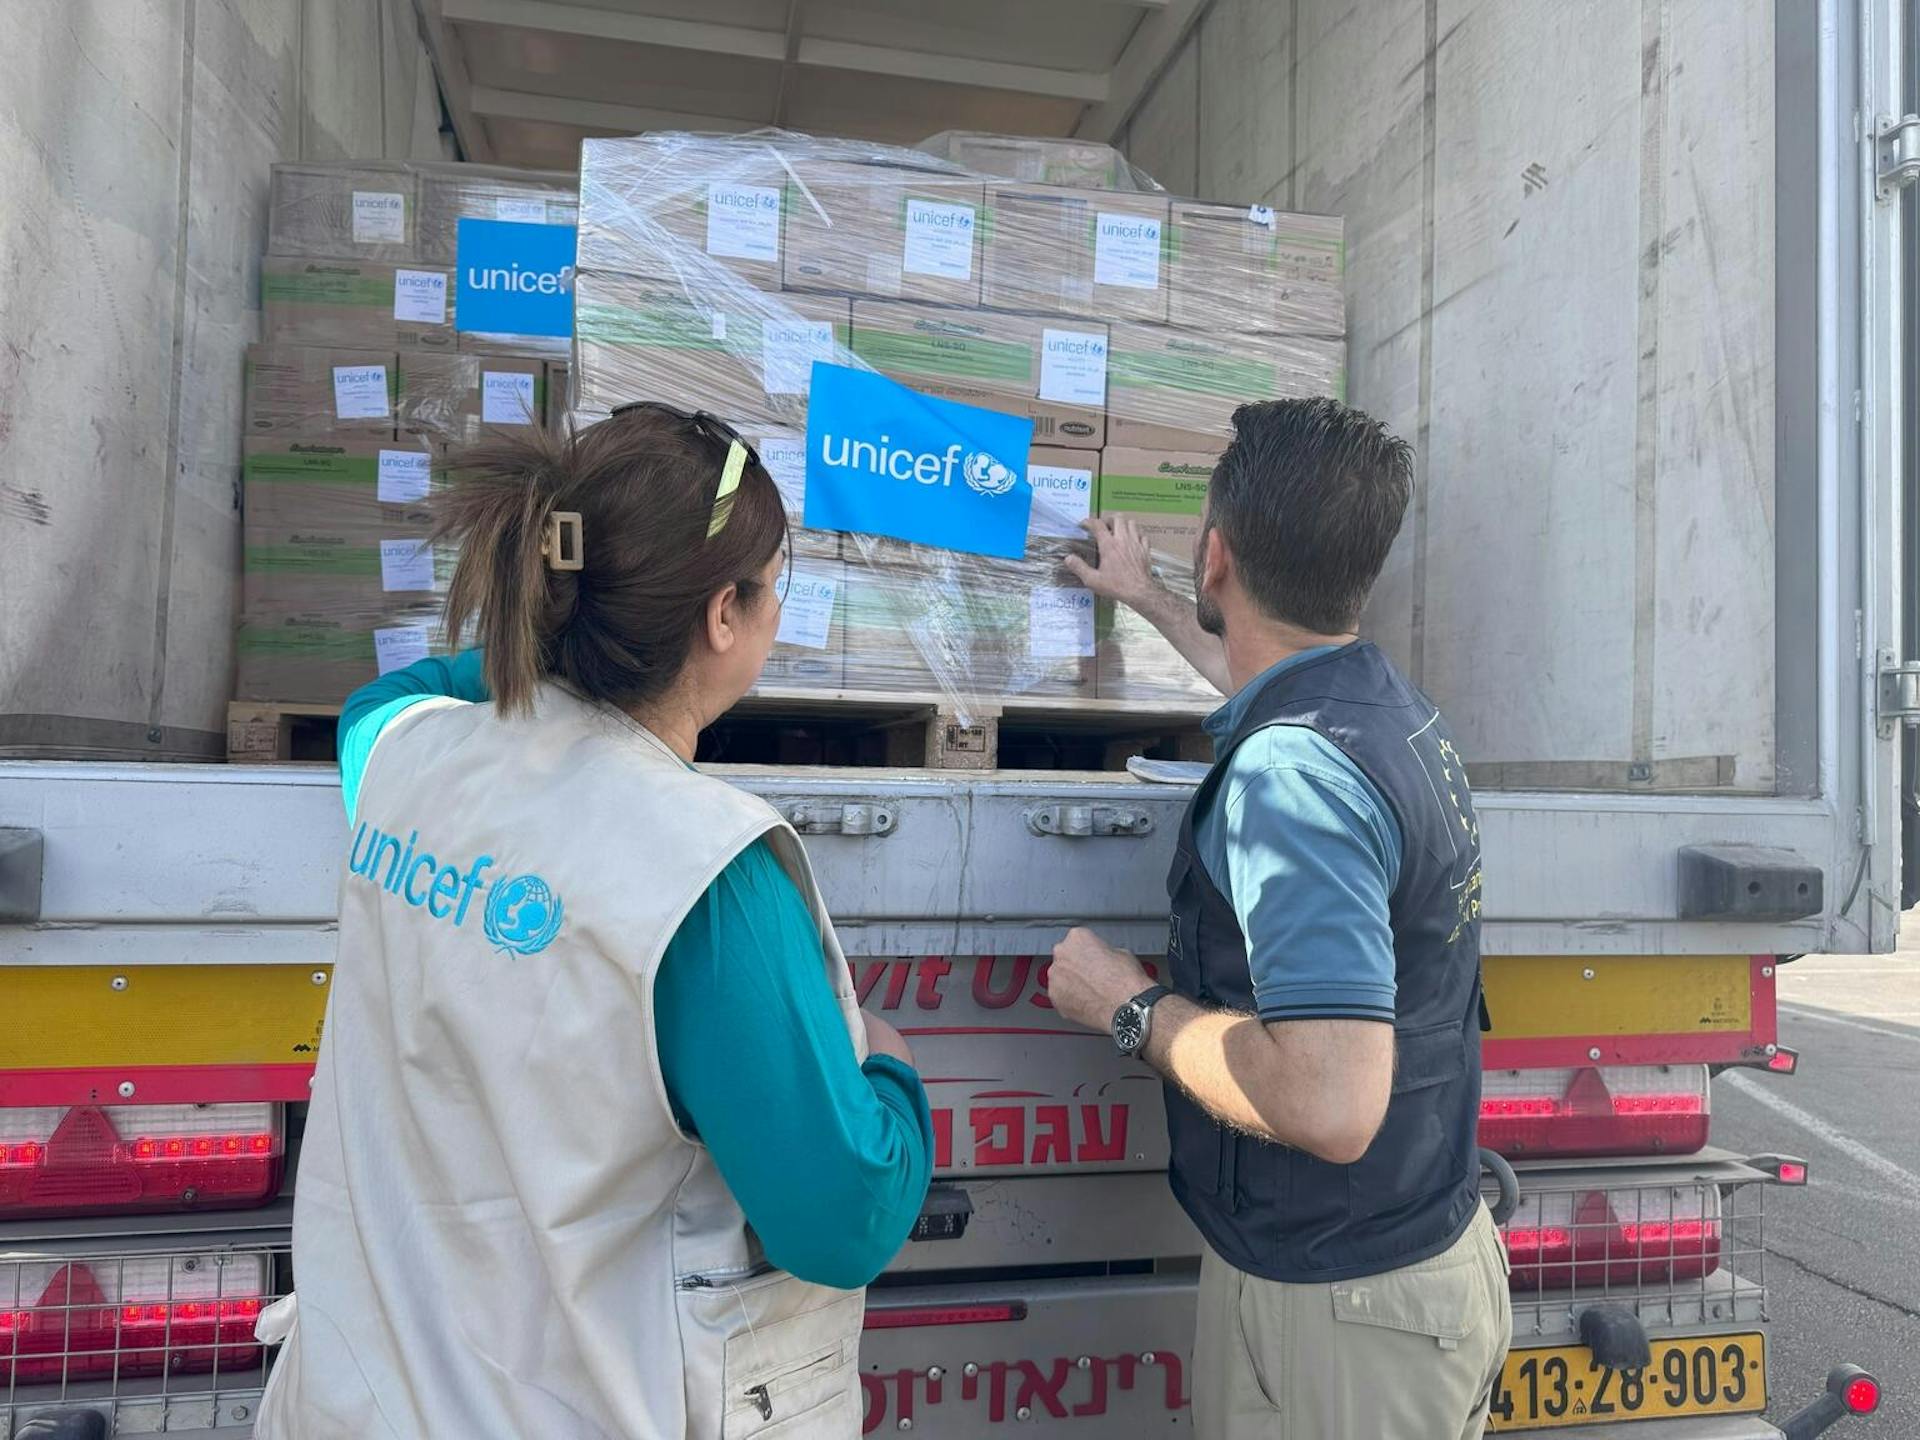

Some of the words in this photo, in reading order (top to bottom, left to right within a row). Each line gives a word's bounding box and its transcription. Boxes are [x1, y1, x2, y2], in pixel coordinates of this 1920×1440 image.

[714, 191, 760, 209] unicef
[913, 210, 956, 228] unicef
[1102, 222, 1143, 240] unicef
[398, 275, 432, 289] unicef
[467, 262, 572, 295] unicef
[1047, 338, 1089, 355] unicef
[336, 370, 371, 384] unicef
[486, 376, 521, 390] unicef
[381, 455, 415, 469] unicef
[821, 433, 963, 488] unicef
[1033, 473, 1075, 490] unicef
[349, 821, 494, 927] unicef
